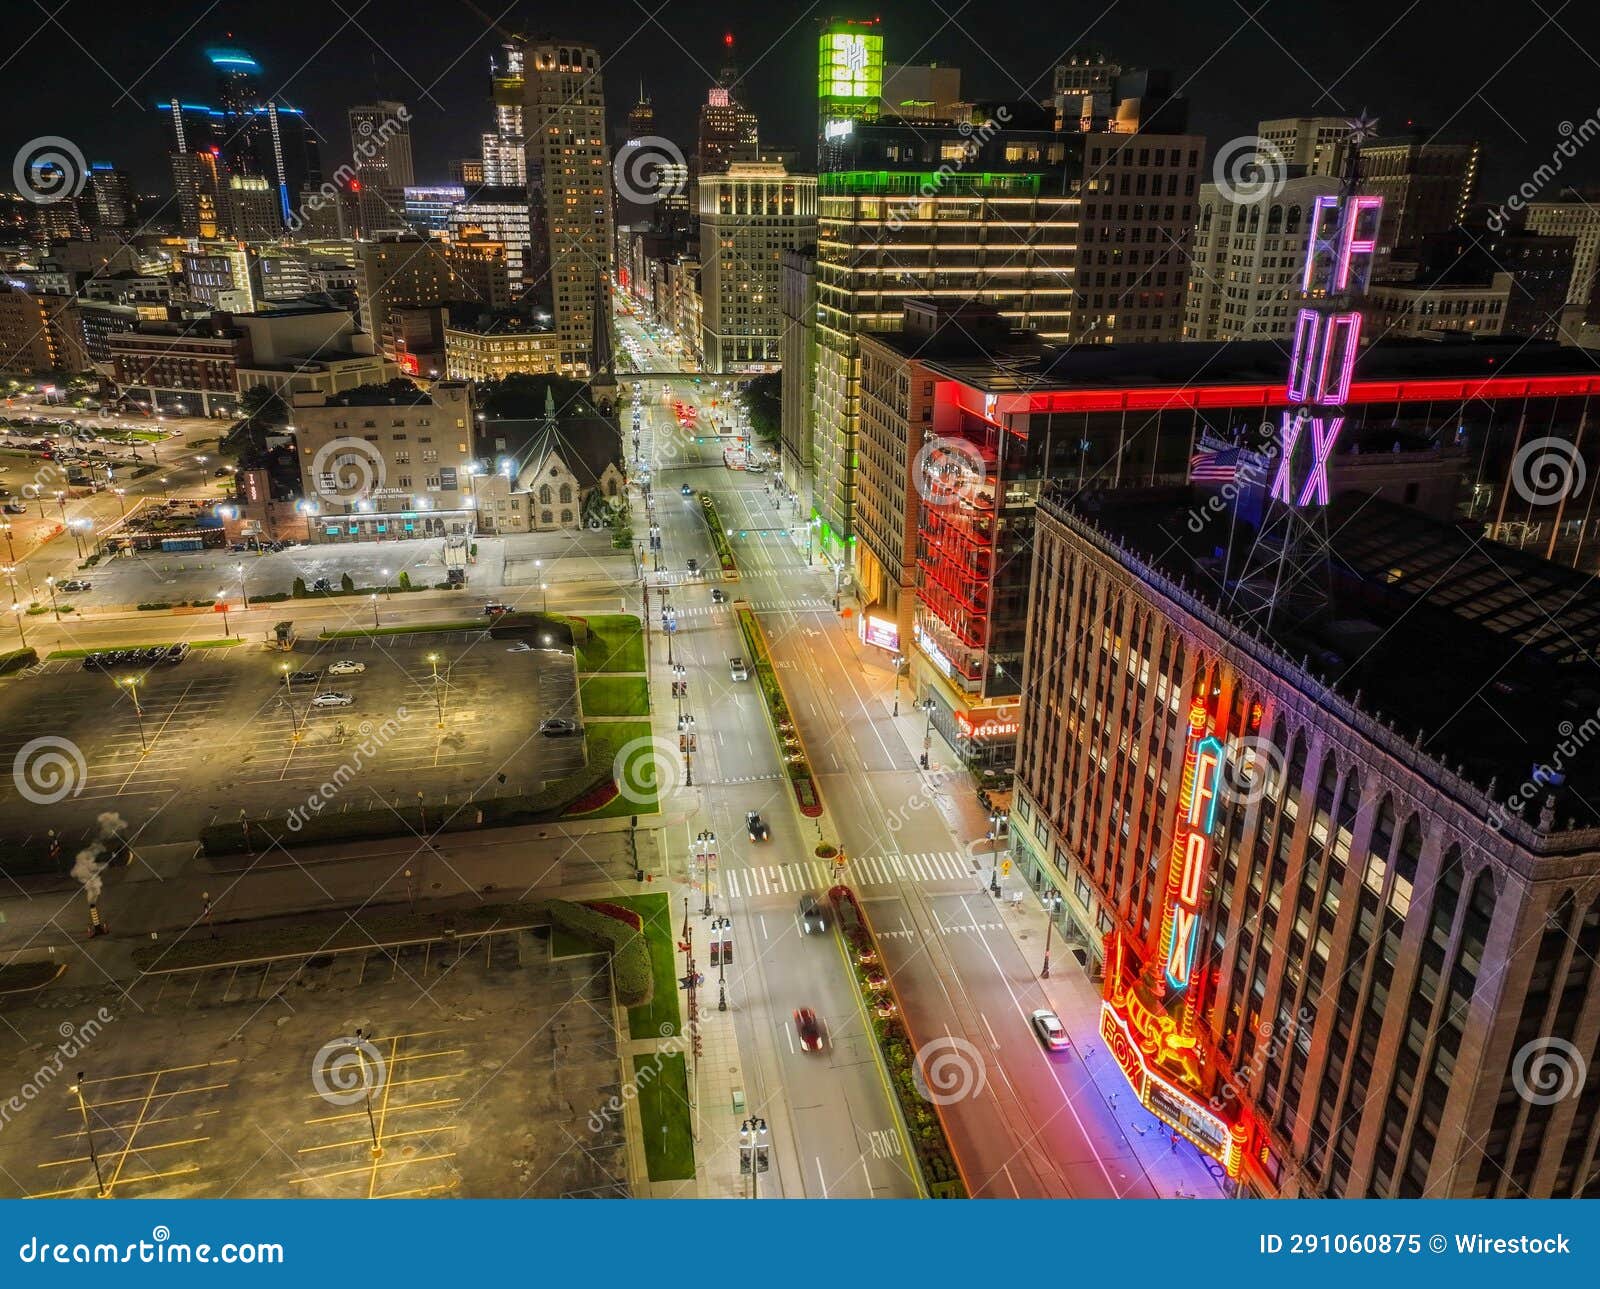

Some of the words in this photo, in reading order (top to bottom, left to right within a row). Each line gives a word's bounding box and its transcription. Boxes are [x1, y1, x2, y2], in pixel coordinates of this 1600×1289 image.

[1298, 196, 1384, 506] FOX
[973, 722, 1020, 737] ASSEMBL
[1168, 754, 1218, 983] FOX
[1103, 1010, 1142, 1097] FOX
[868, 1129, 901, 1159] ONLY
